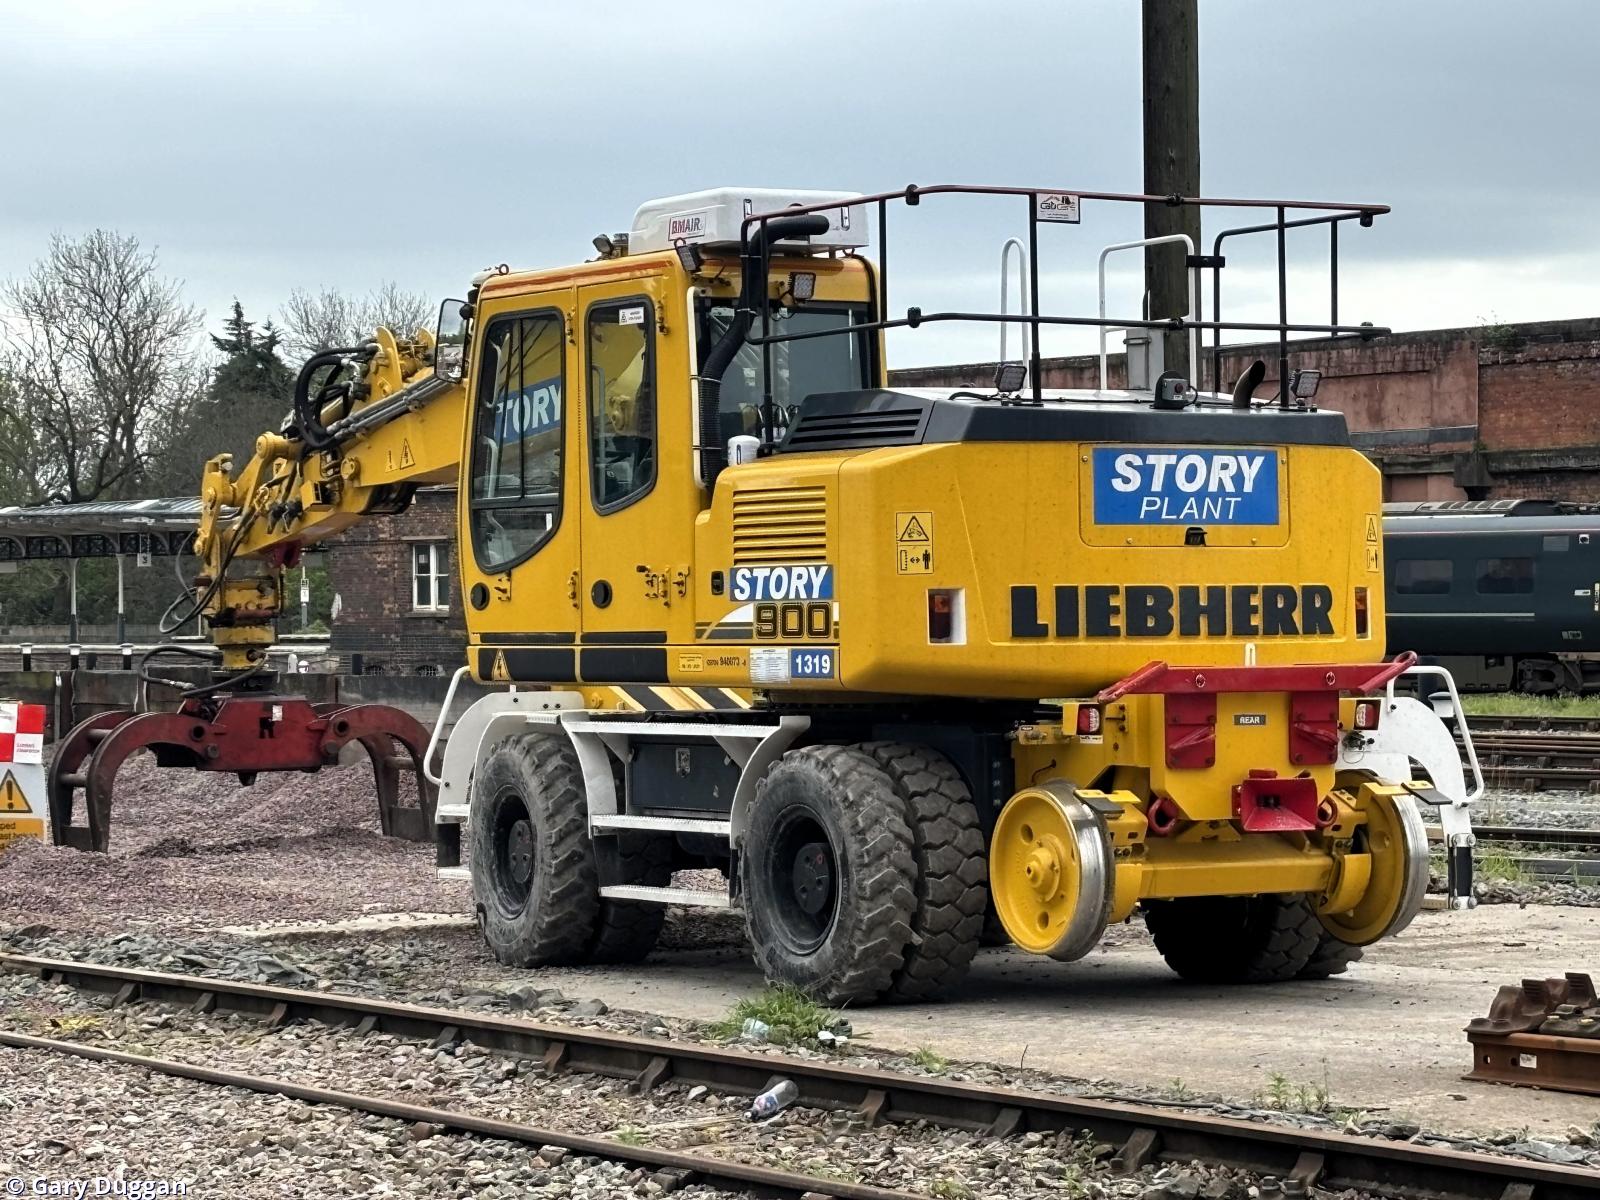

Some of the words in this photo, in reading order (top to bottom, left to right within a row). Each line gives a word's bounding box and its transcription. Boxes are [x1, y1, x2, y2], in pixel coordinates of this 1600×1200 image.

[496, 384, 561, 438] TORY
[1111, 453, 1266, 493] STORY
[1139, 496, 1242, 520] PLANT
[733, 565, 829, 601] STORY
[755, 602, 832, 639] 900
[1009, 584, 1335, 638] LIEBHERR
[795, 653, 831, 675] 1319
[1239, 716, 1260, 724] REAR
